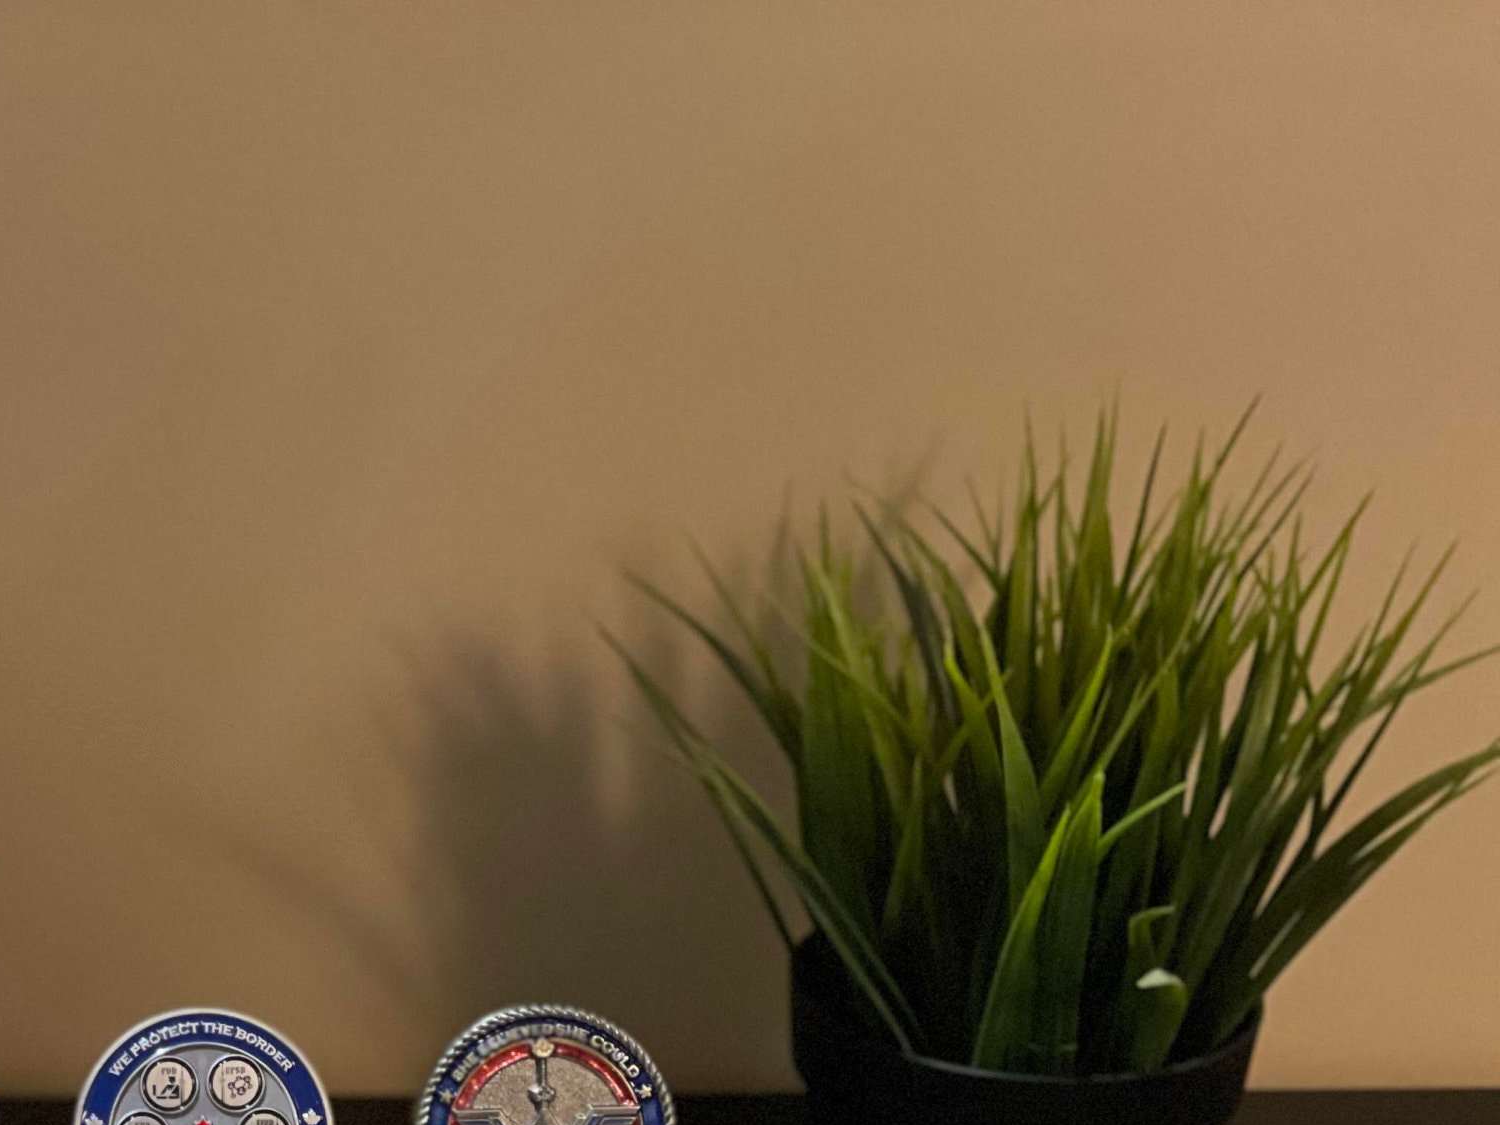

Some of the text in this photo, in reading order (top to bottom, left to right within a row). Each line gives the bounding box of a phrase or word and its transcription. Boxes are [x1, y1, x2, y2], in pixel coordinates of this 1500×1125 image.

[108, 1021, 296, 1077] WE PROTECT THE BORDER
[590, 1034, 640, 1079] COULD
